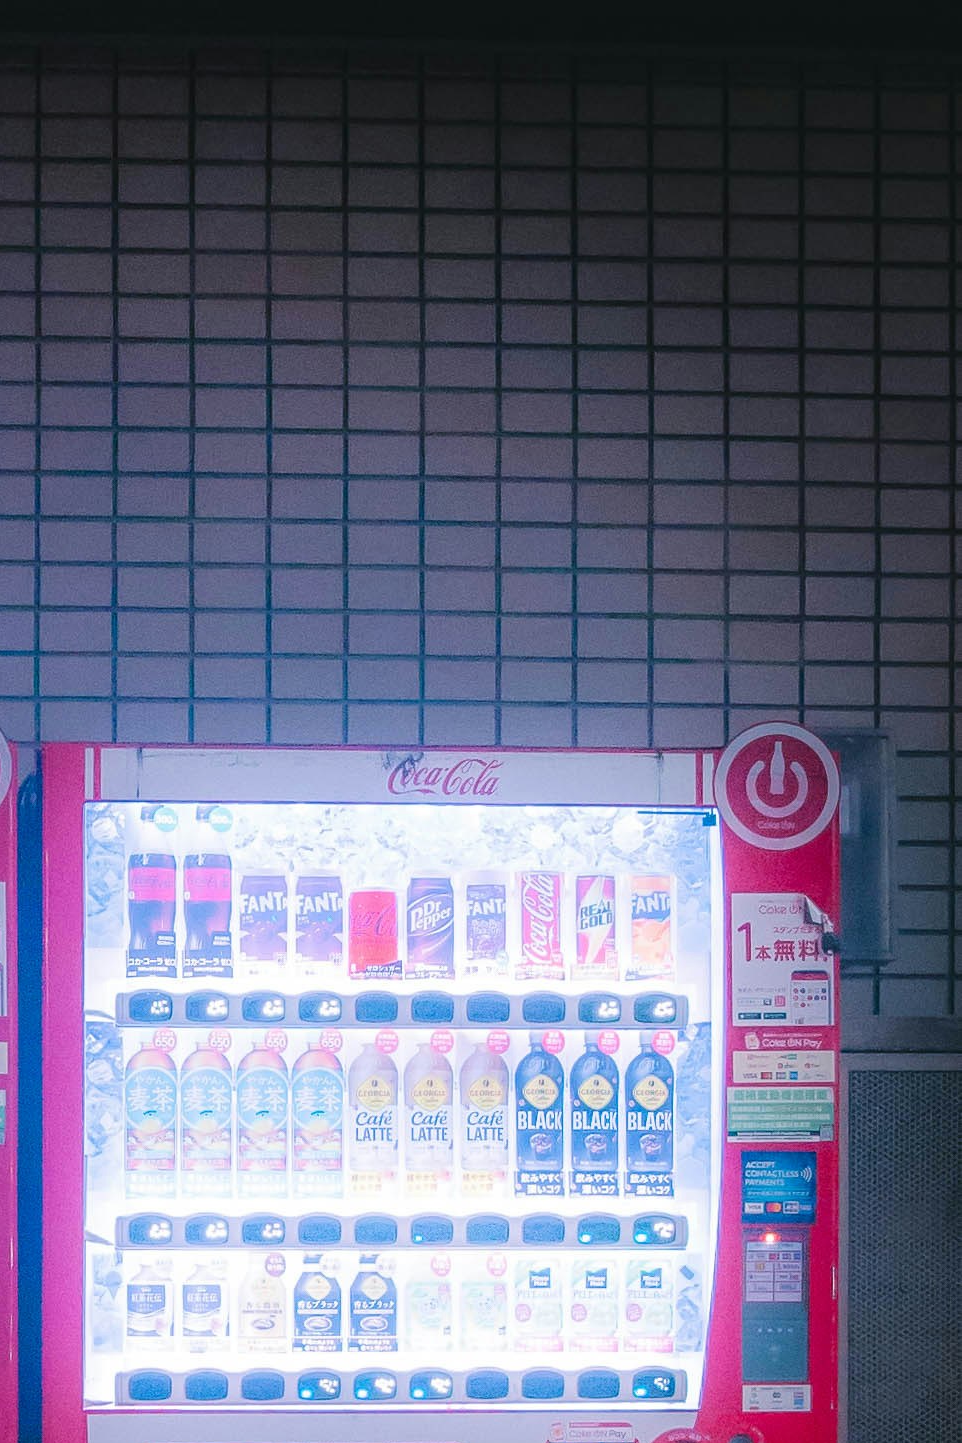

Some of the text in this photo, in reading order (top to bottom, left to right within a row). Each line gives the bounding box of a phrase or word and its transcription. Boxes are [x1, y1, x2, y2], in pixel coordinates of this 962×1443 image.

[424, 900, 441, 915] Dr
[580, 898, 612, 918] REAL
[758, 904, 787, 915] Coke
[411, 906, 451, 932] Pepper
[580, 912, 613, 930] GOLD
[737, 921, 828, 962] 1本無料
[803, 1039, 823, 1048] Pay
[128, 1085, 175, 1113] 麦茶
[184, 1085, 230, 1113] 麦茶
[240, 1085, 285, 1113] 麦茶
[296, 1085, 340, 1113] 麦茶
[355, 1110, 392, 1126] Café
[411, 1110, 447, 1126] Café
[467, 1110, 503, 1126] Café
[517, 1111, 563, 1130] BLACK
[573, 1111, 617, 1130] BLACK
[628, 1112, 672, 1131] BLACK
[355, 1127, 393, 1142] LATTE
[411, 1127, 448, 1142] LATTE
[467, 1127, 504, 1142] LATTE
[745, 1161, 775, 1169] ACCEPT
[745, 1170, 799, 1178] CONTACTLESS
[745, 1178, 785, 1186] PAYMENTS
[609, 1429, 626, 1439] Pay
